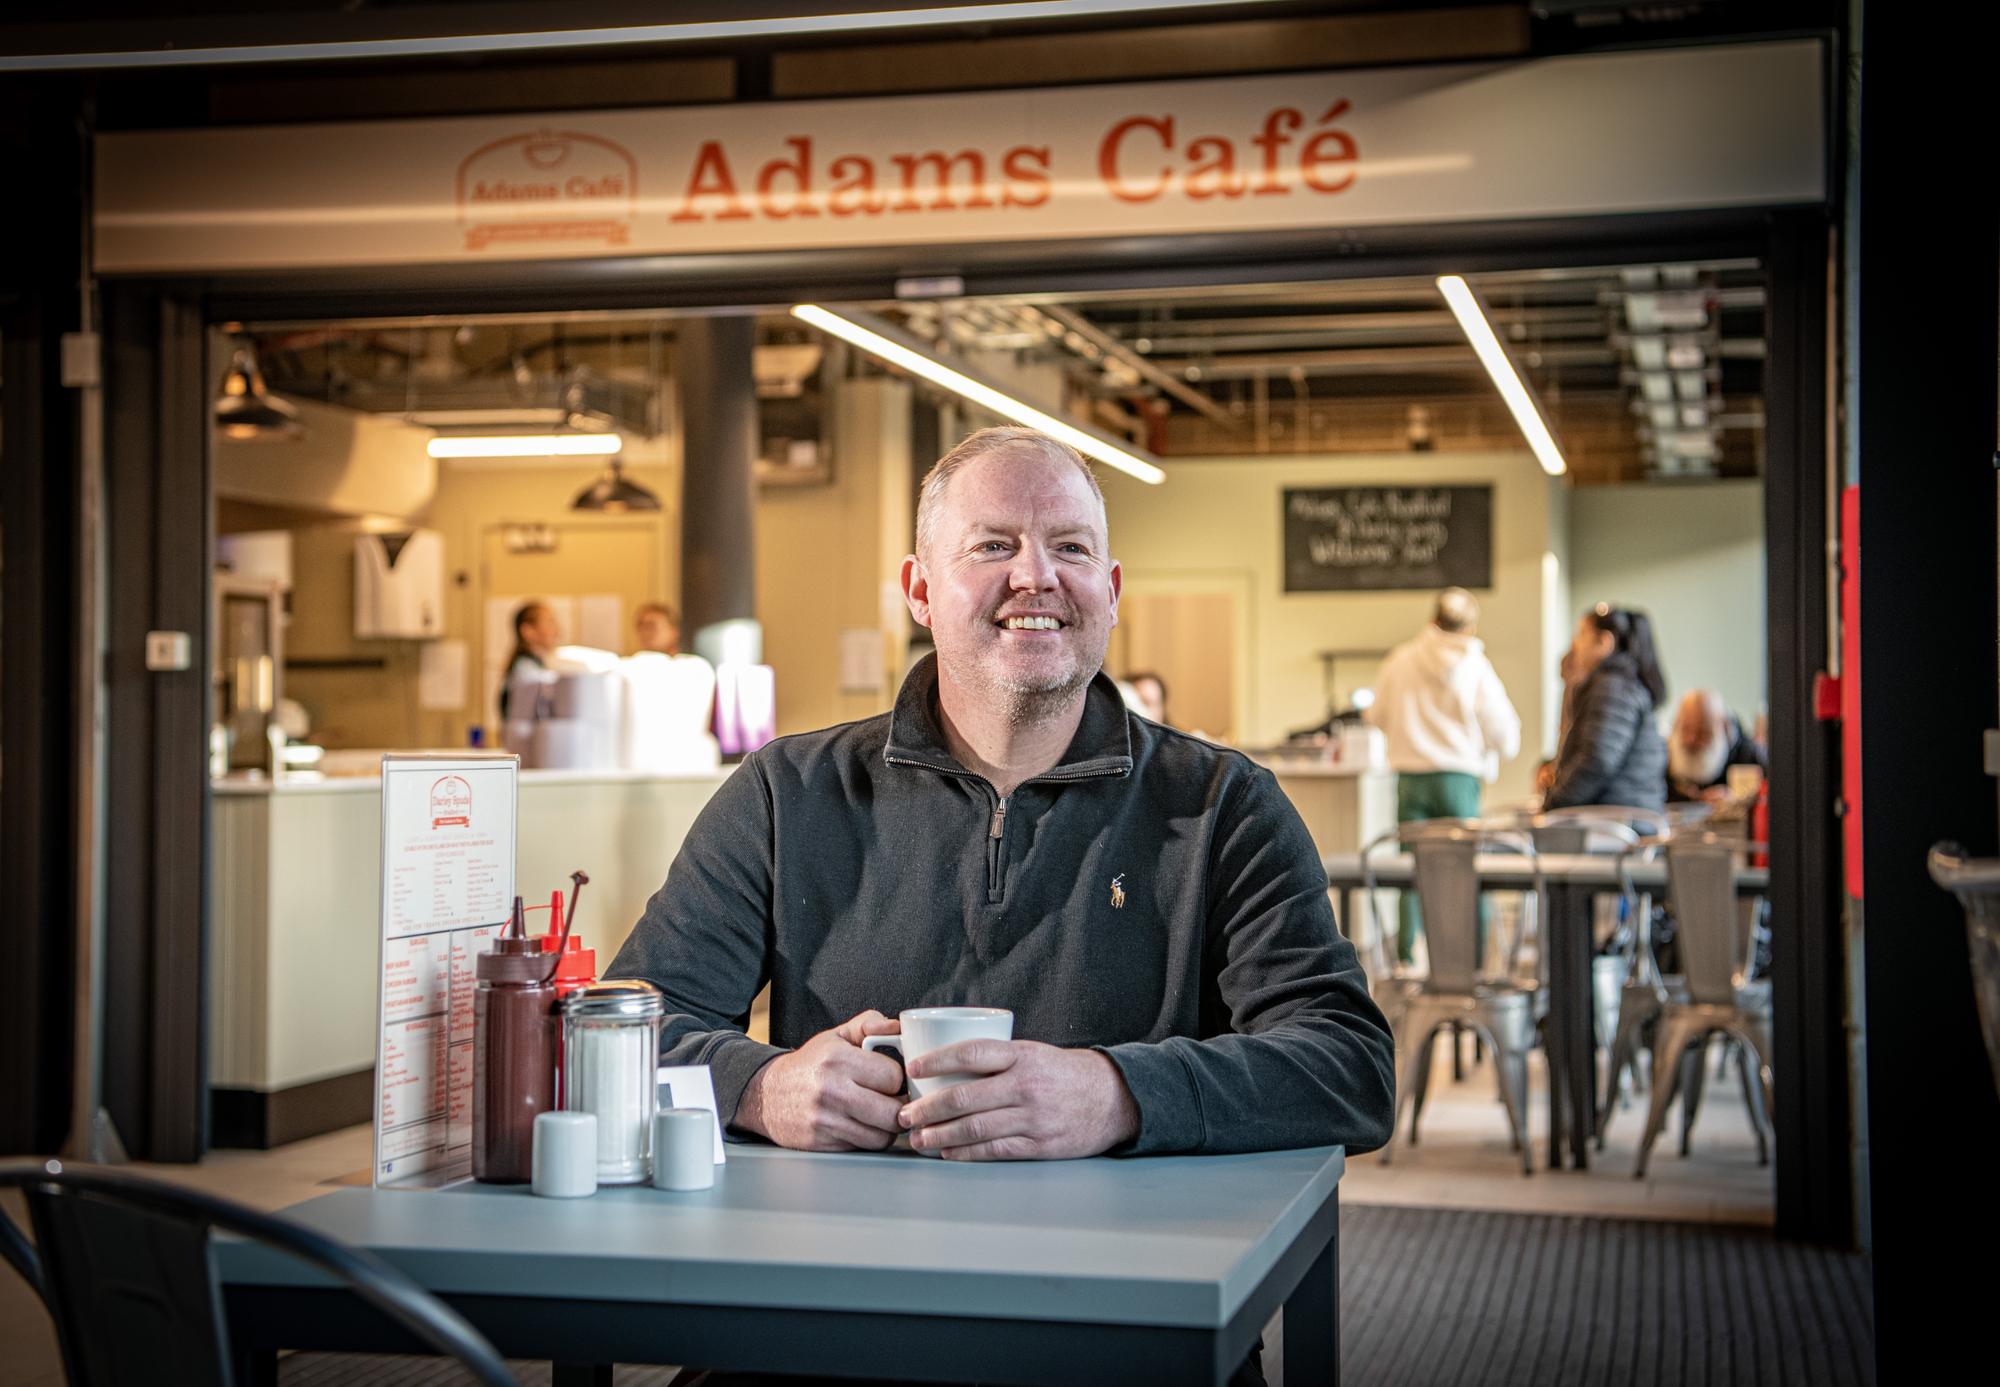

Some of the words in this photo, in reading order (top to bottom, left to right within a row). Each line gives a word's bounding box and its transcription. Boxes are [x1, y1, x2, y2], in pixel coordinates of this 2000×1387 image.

[472, 179, 559, 200] Adams
[565, 174, 625, 199] Café
[671, 137, 1052, 222] Adams
[1099, 99, 1360, 203] Café
